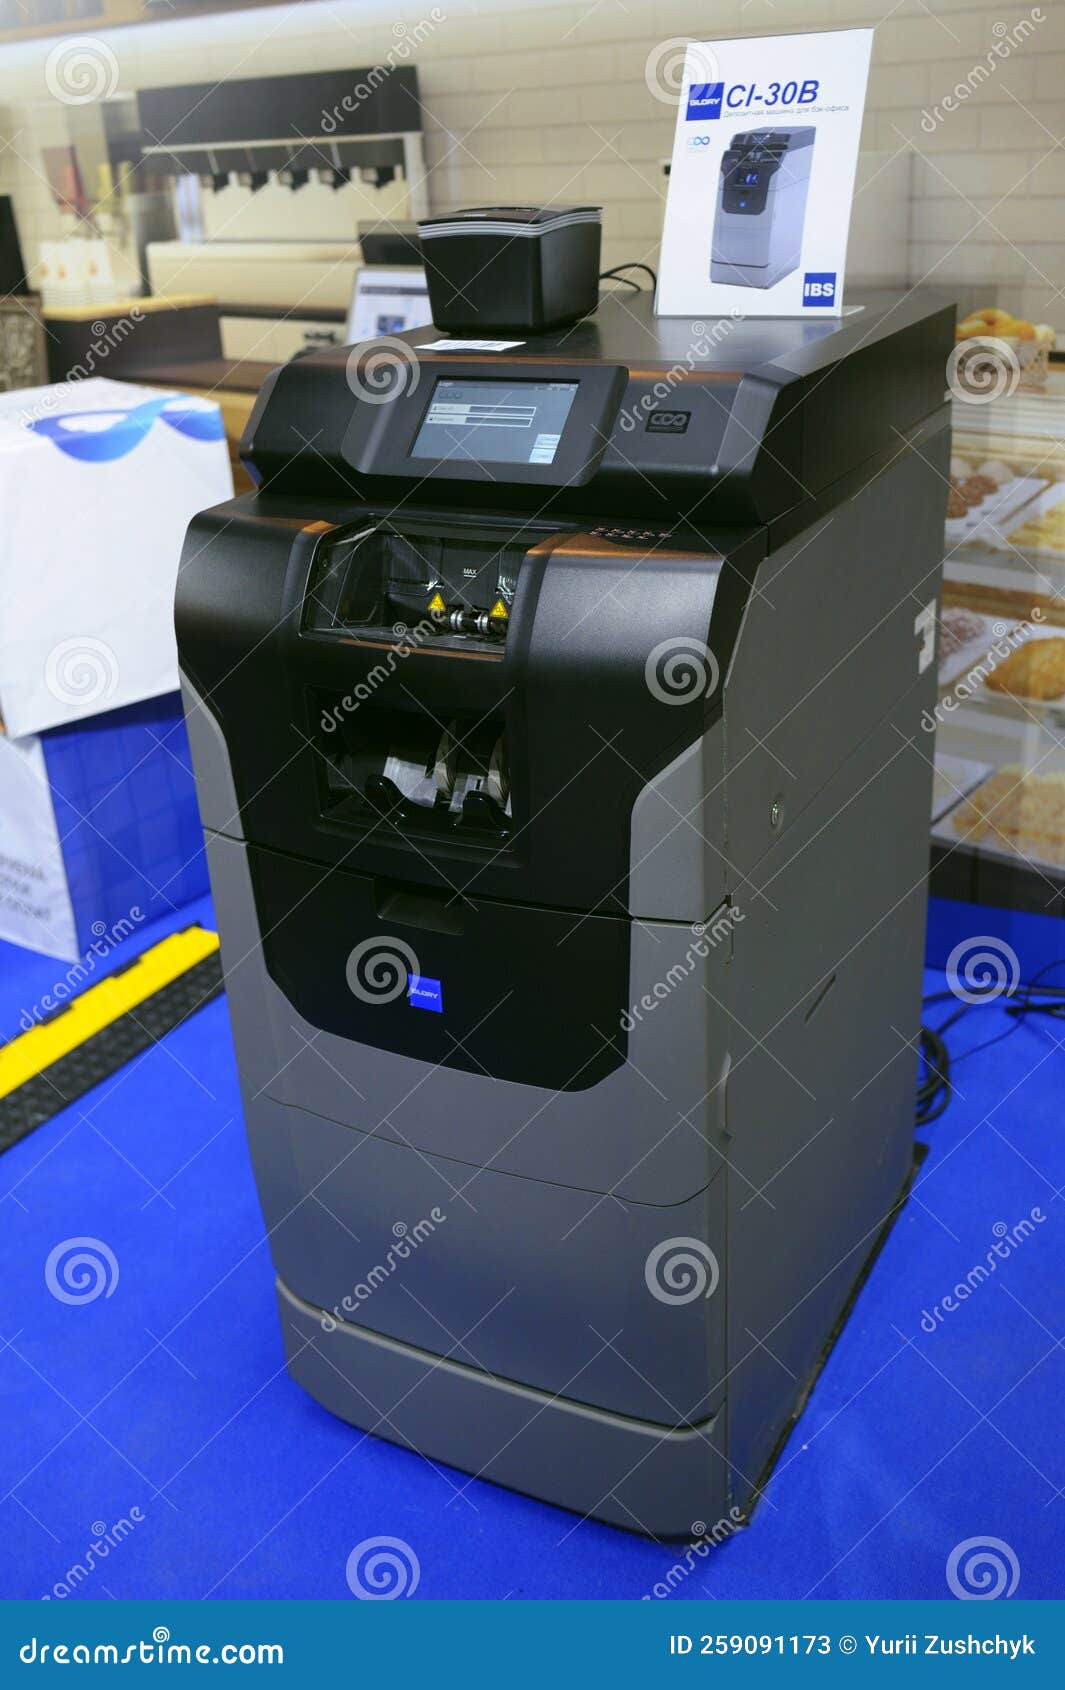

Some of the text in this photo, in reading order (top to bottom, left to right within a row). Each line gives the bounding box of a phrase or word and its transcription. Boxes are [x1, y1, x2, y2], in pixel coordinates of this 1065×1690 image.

[690, 98, 721, 106] GLORY
[726, 80, 819, 108] CI-30B
[804, 282, 834, 298] IBS
